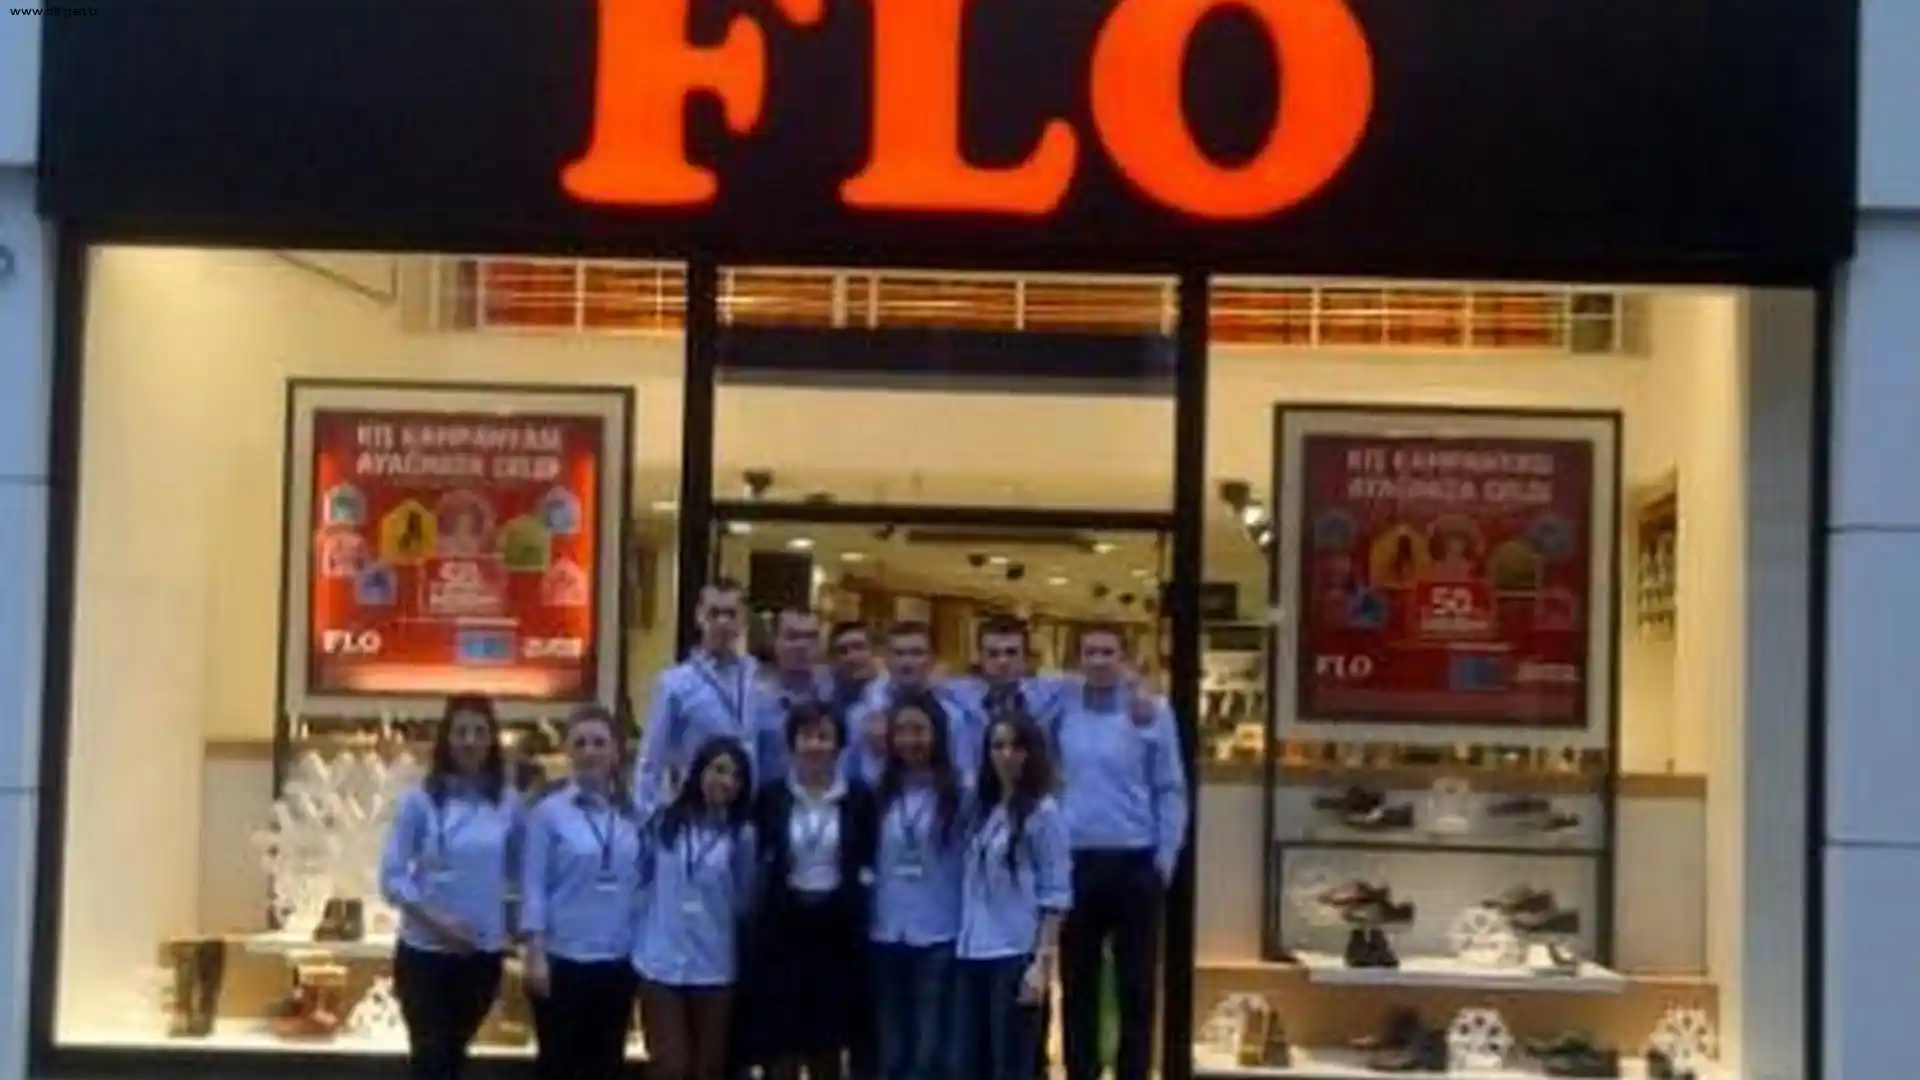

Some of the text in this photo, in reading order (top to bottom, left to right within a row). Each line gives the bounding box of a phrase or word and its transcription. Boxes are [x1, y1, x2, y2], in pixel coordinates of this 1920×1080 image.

[560, 0, 1374, 218] FLO
[322, 629, 382, 655] FLO
[1316, 654, 1374, 679] FLO
